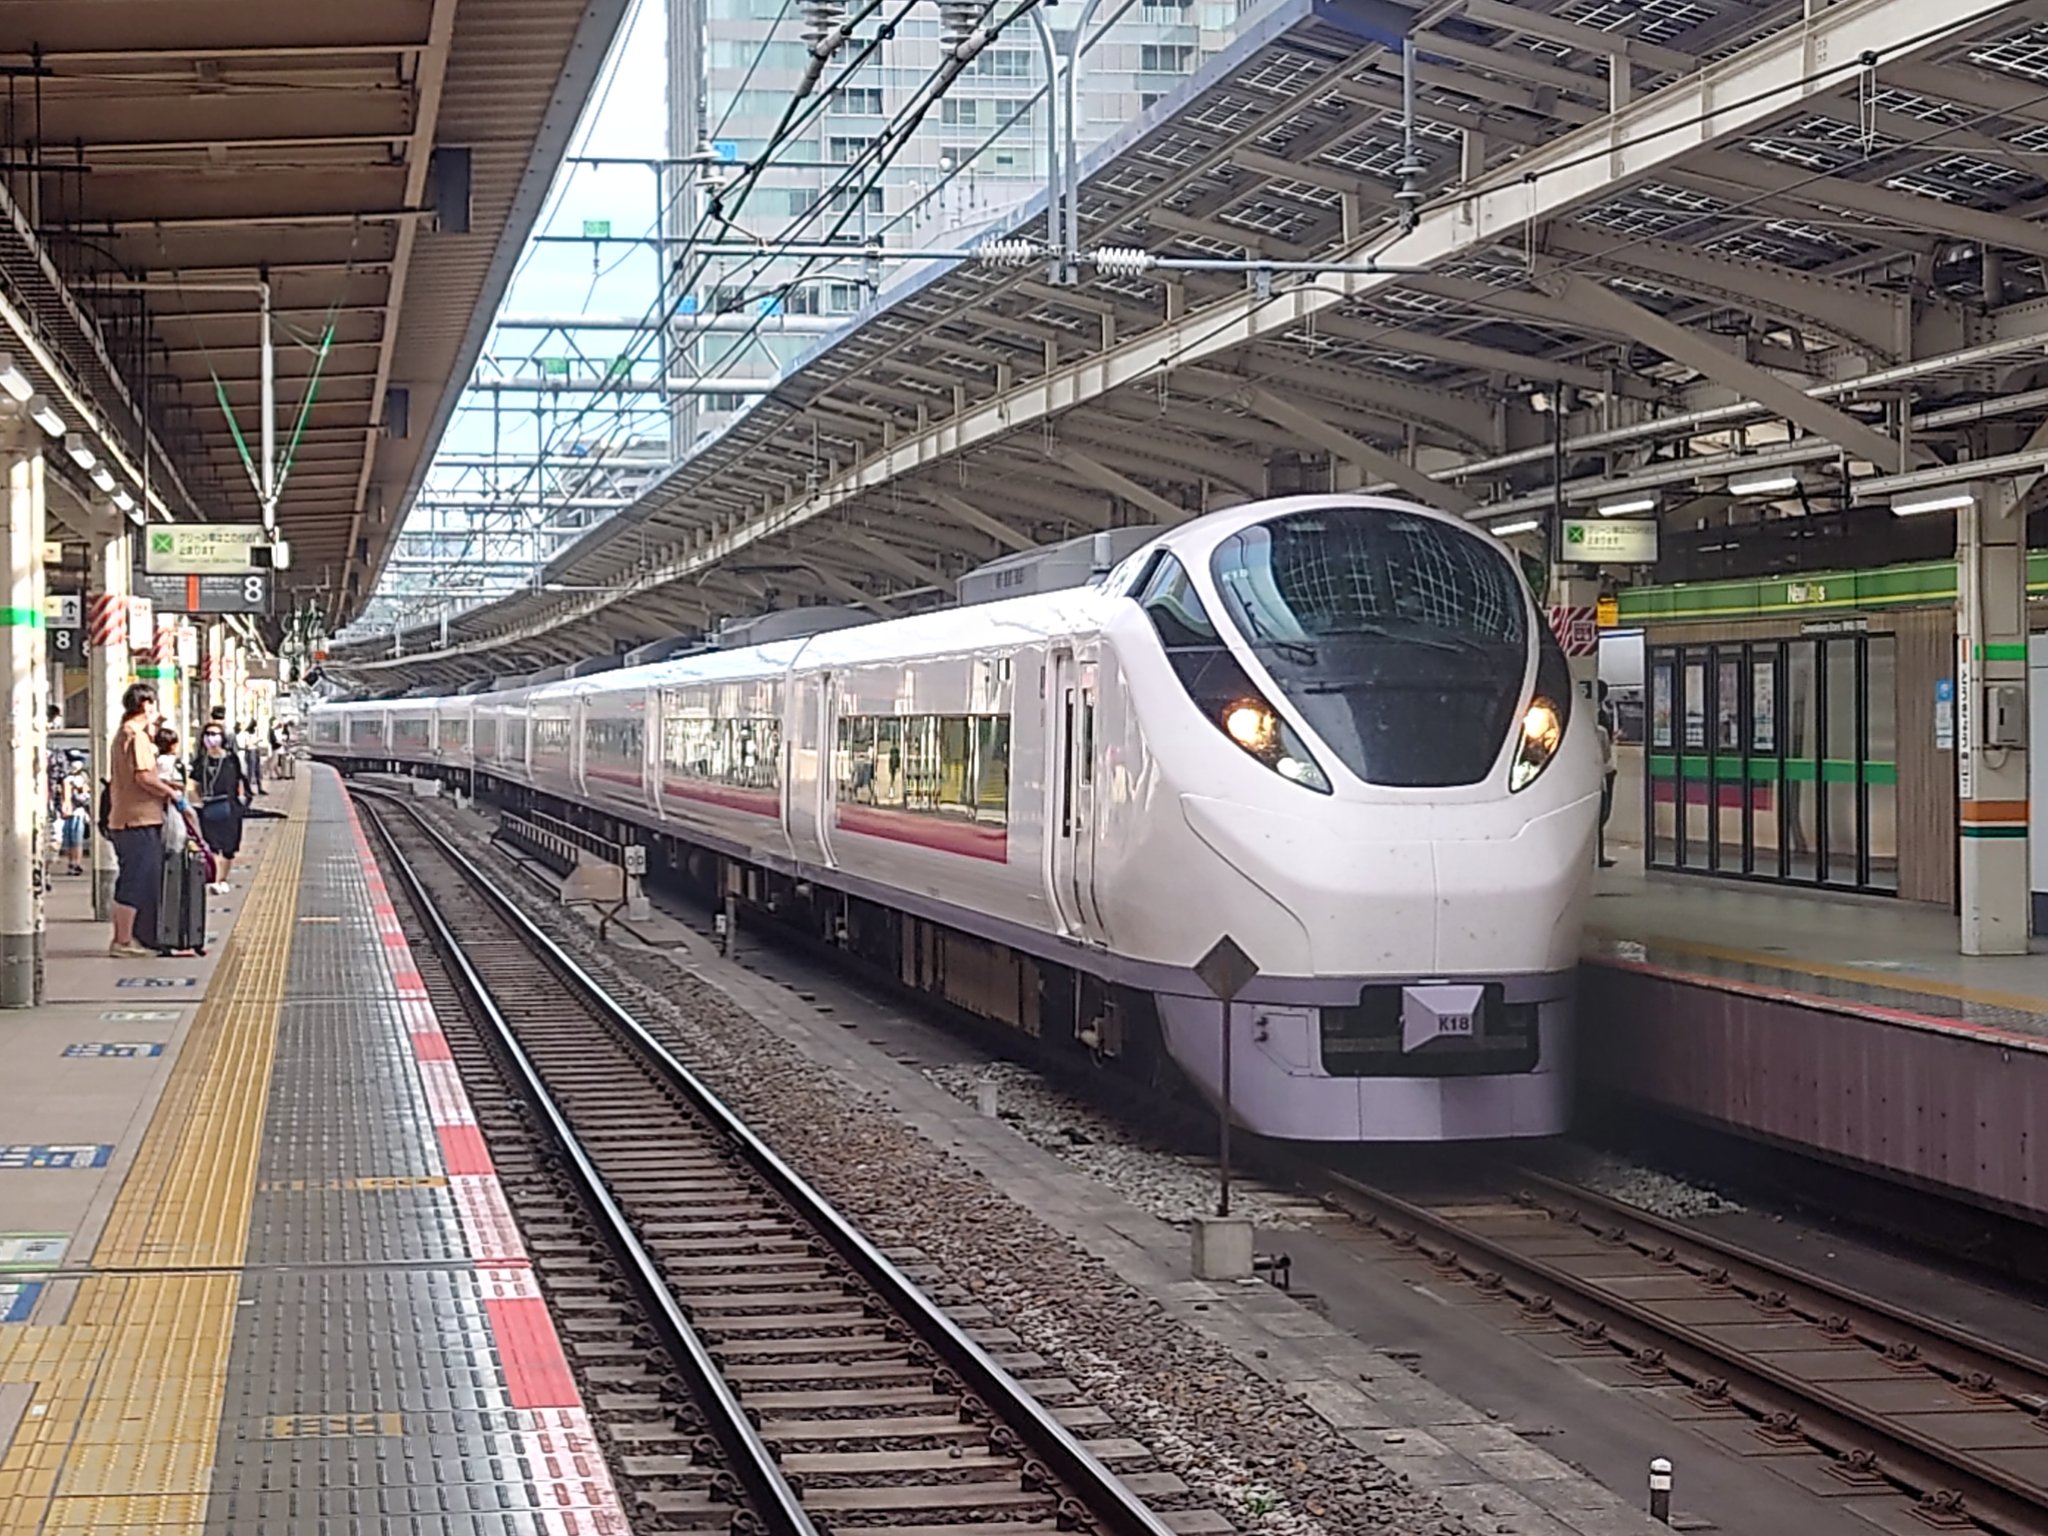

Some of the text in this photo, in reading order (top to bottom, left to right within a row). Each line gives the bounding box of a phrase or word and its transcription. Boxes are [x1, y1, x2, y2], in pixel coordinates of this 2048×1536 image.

[244, 576, 263, 602] 8
[55, 630, 71, 650] 8
[1439, 1016, 1470, 1031] K18
